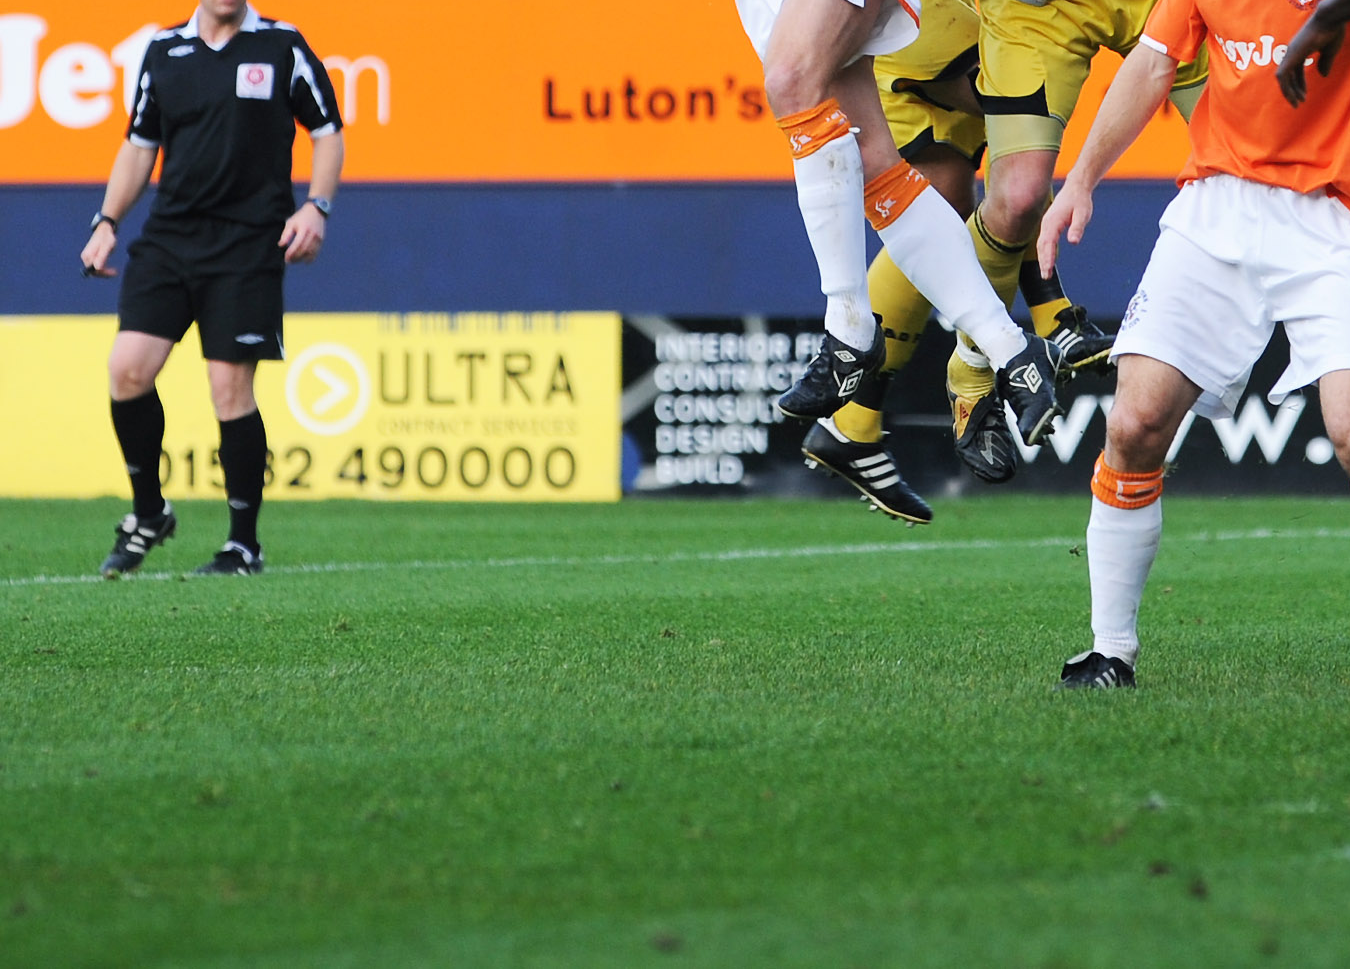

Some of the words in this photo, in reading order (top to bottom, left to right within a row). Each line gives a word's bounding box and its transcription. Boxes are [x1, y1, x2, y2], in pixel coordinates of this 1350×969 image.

[543, 76, 764, 121] Luton's
[656, 332, 792, 363] INTERIOR
[378, 350, 576, 405] ULTRA
[481, 417, 579, 436] SERVICES
[655, 424, 768, 454] DESIGN
[338, 445, 577, 489] 490000
[655, 455, 744, 485] BUILD
